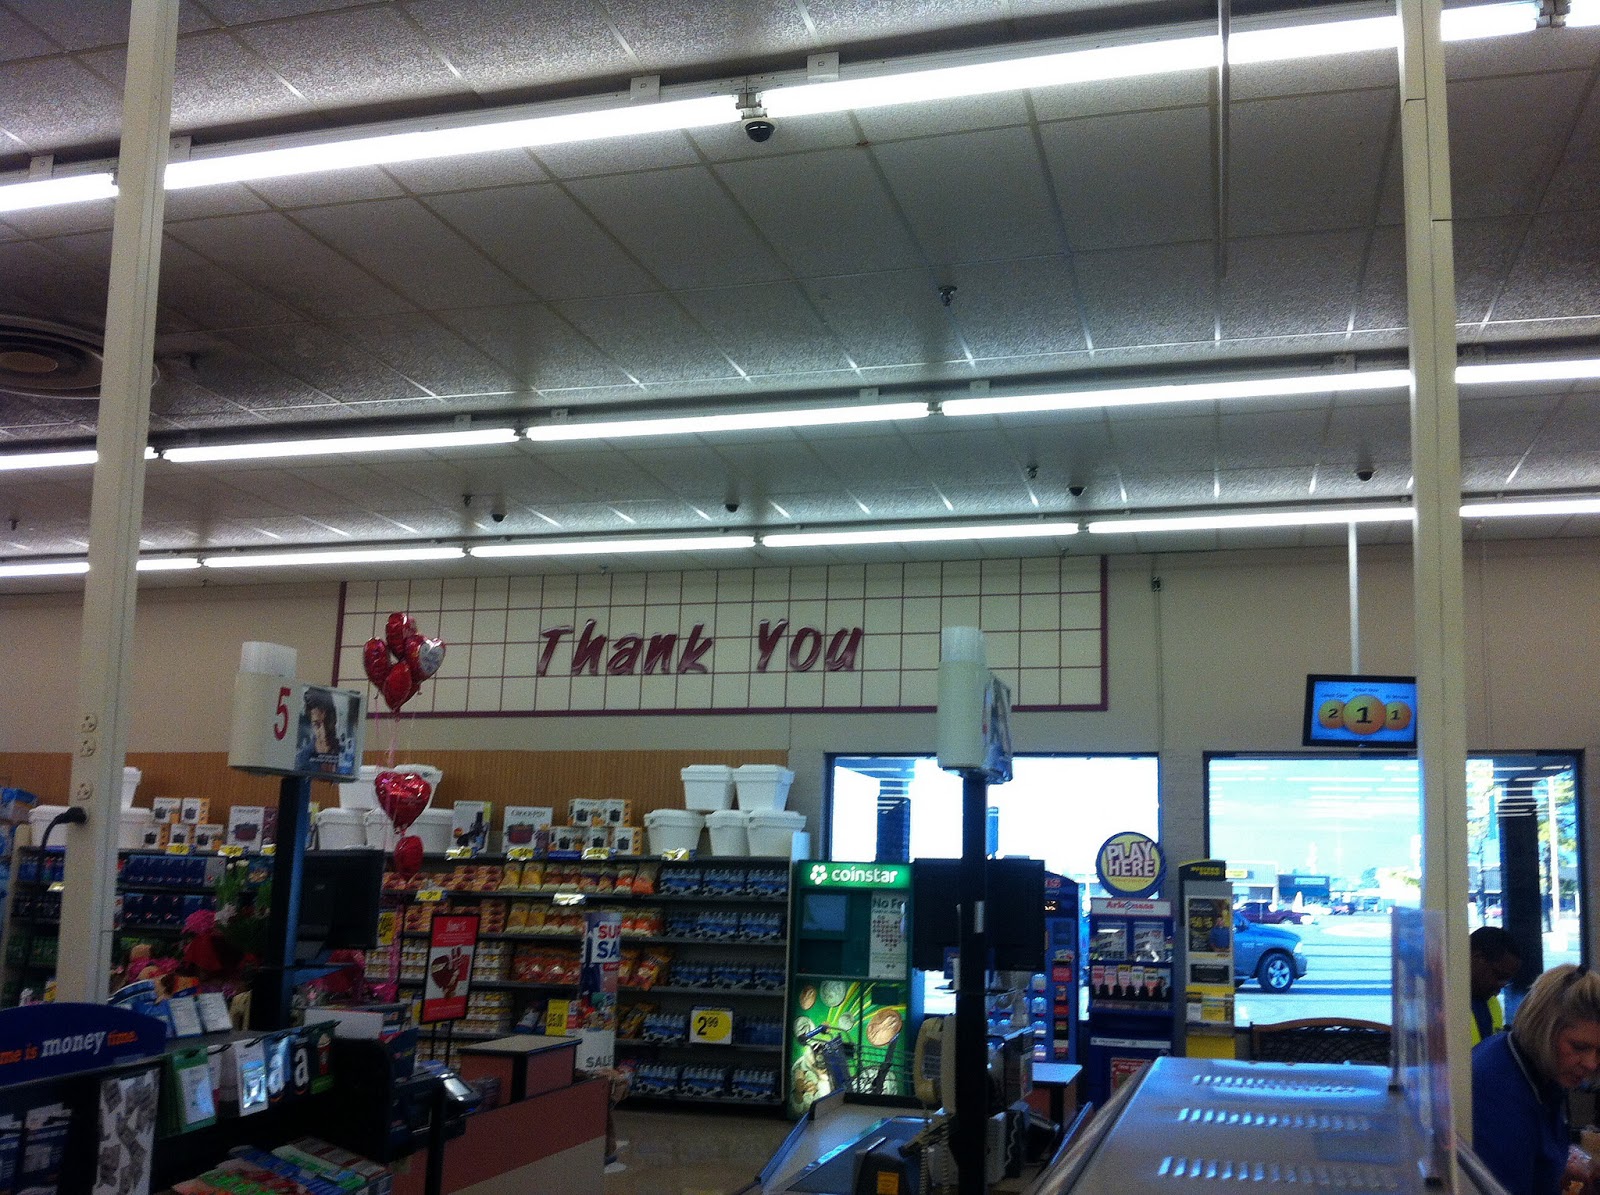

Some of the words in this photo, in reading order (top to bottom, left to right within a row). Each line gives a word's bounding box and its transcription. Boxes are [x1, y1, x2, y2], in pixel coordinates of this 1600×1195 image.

[536, 618, 713, 676] Thank
[273, 687, 291, 741] 5
[1328, 708, 1339, 718] 2
[1356, 706, 1372, 723] 1
[1391, 709, 1400, 720] 1
[1106, 841, 1154, 862] PLAY
[831, 866, 899, 883] coinstar
[1107, 858, 1156, 877] HERE
[23, 1042, 38, 1060] is
[40, 1031, 107, 1057] money
